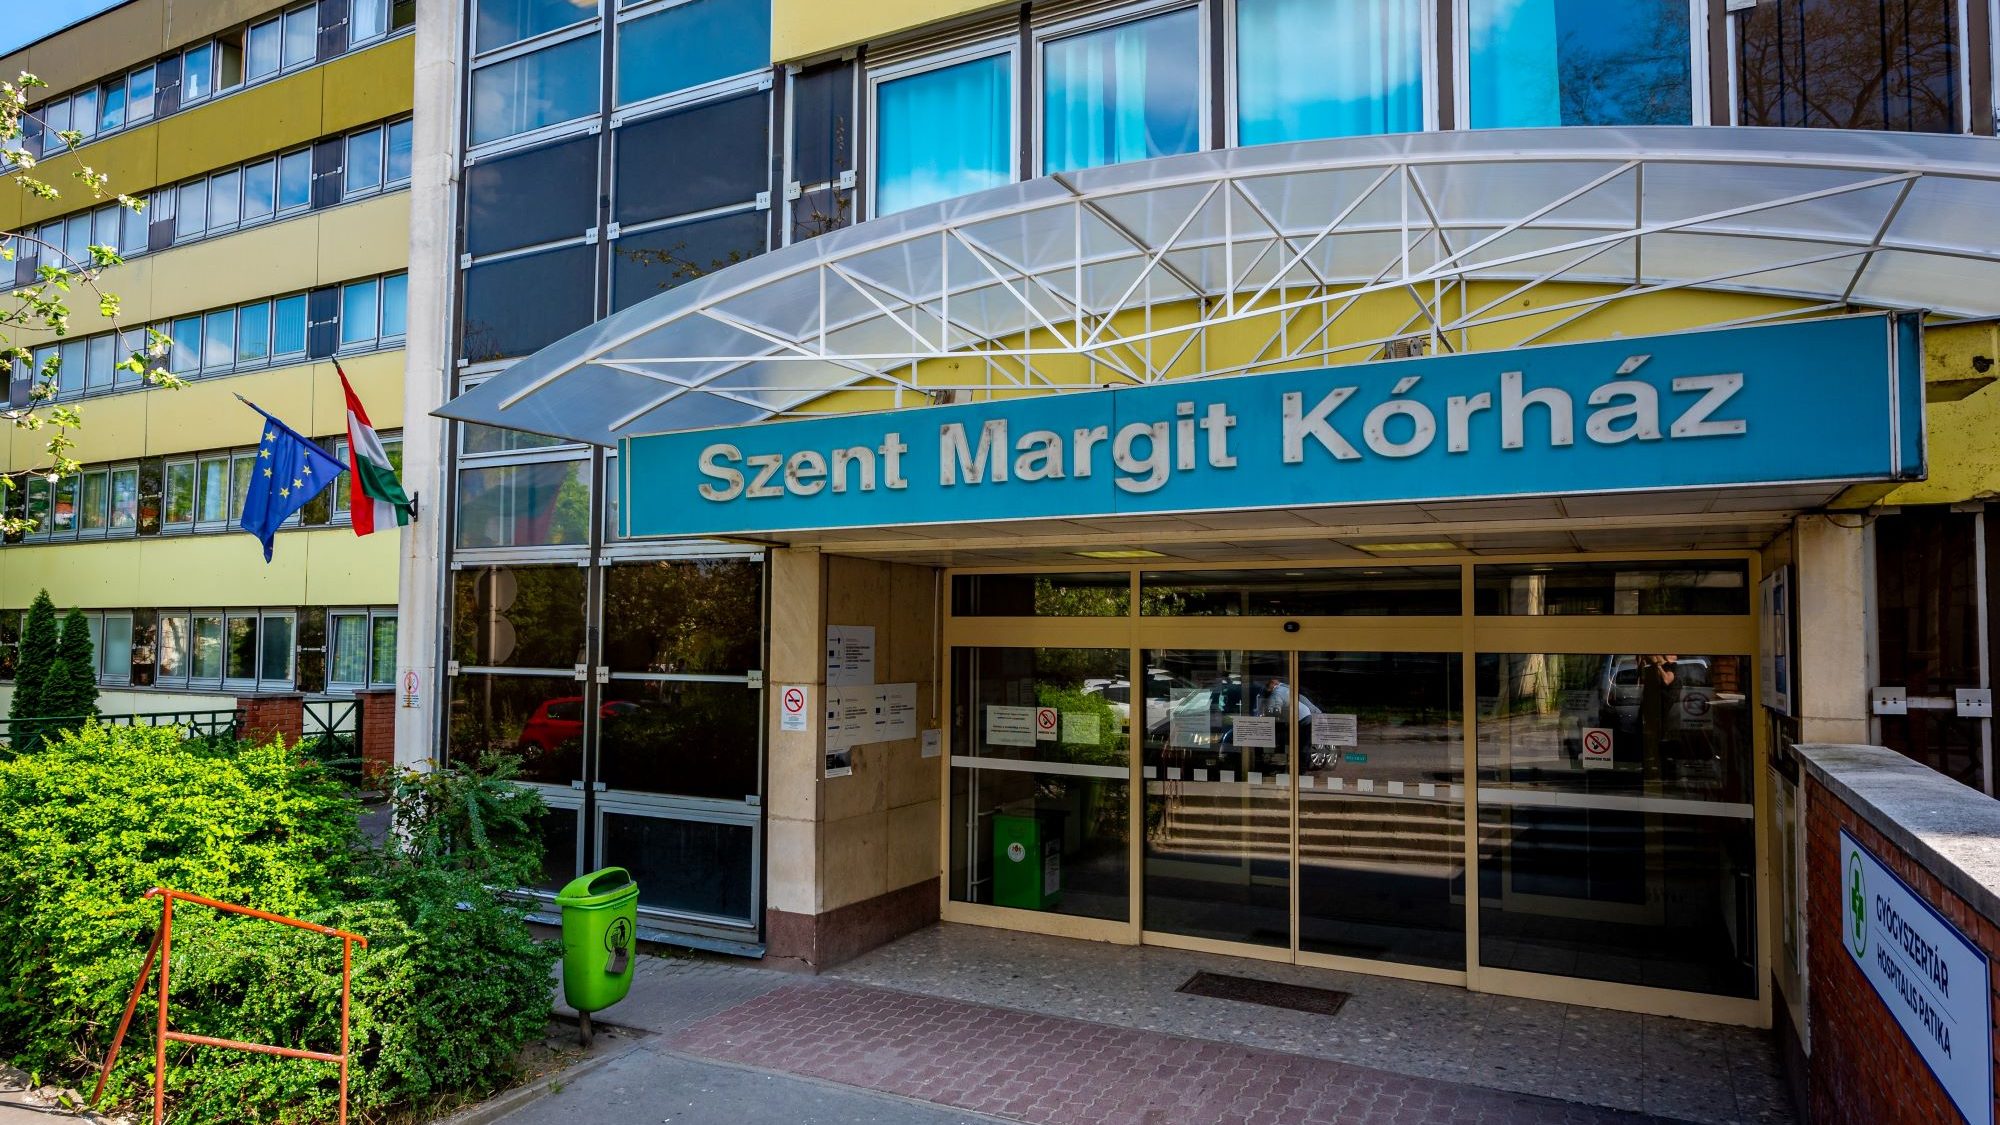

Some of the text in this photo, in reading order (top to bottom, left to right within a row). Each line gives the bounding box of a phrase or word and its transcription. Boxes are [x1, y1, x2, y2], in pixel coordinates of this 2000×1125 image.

[698, 354, 1747, 502] Szent Margit Kórház
[1876, 894, 1949, 998] GYÓGYSZERTÁR
[1877, 942, 1951, 1060] HOSPITALIS PATIKA
